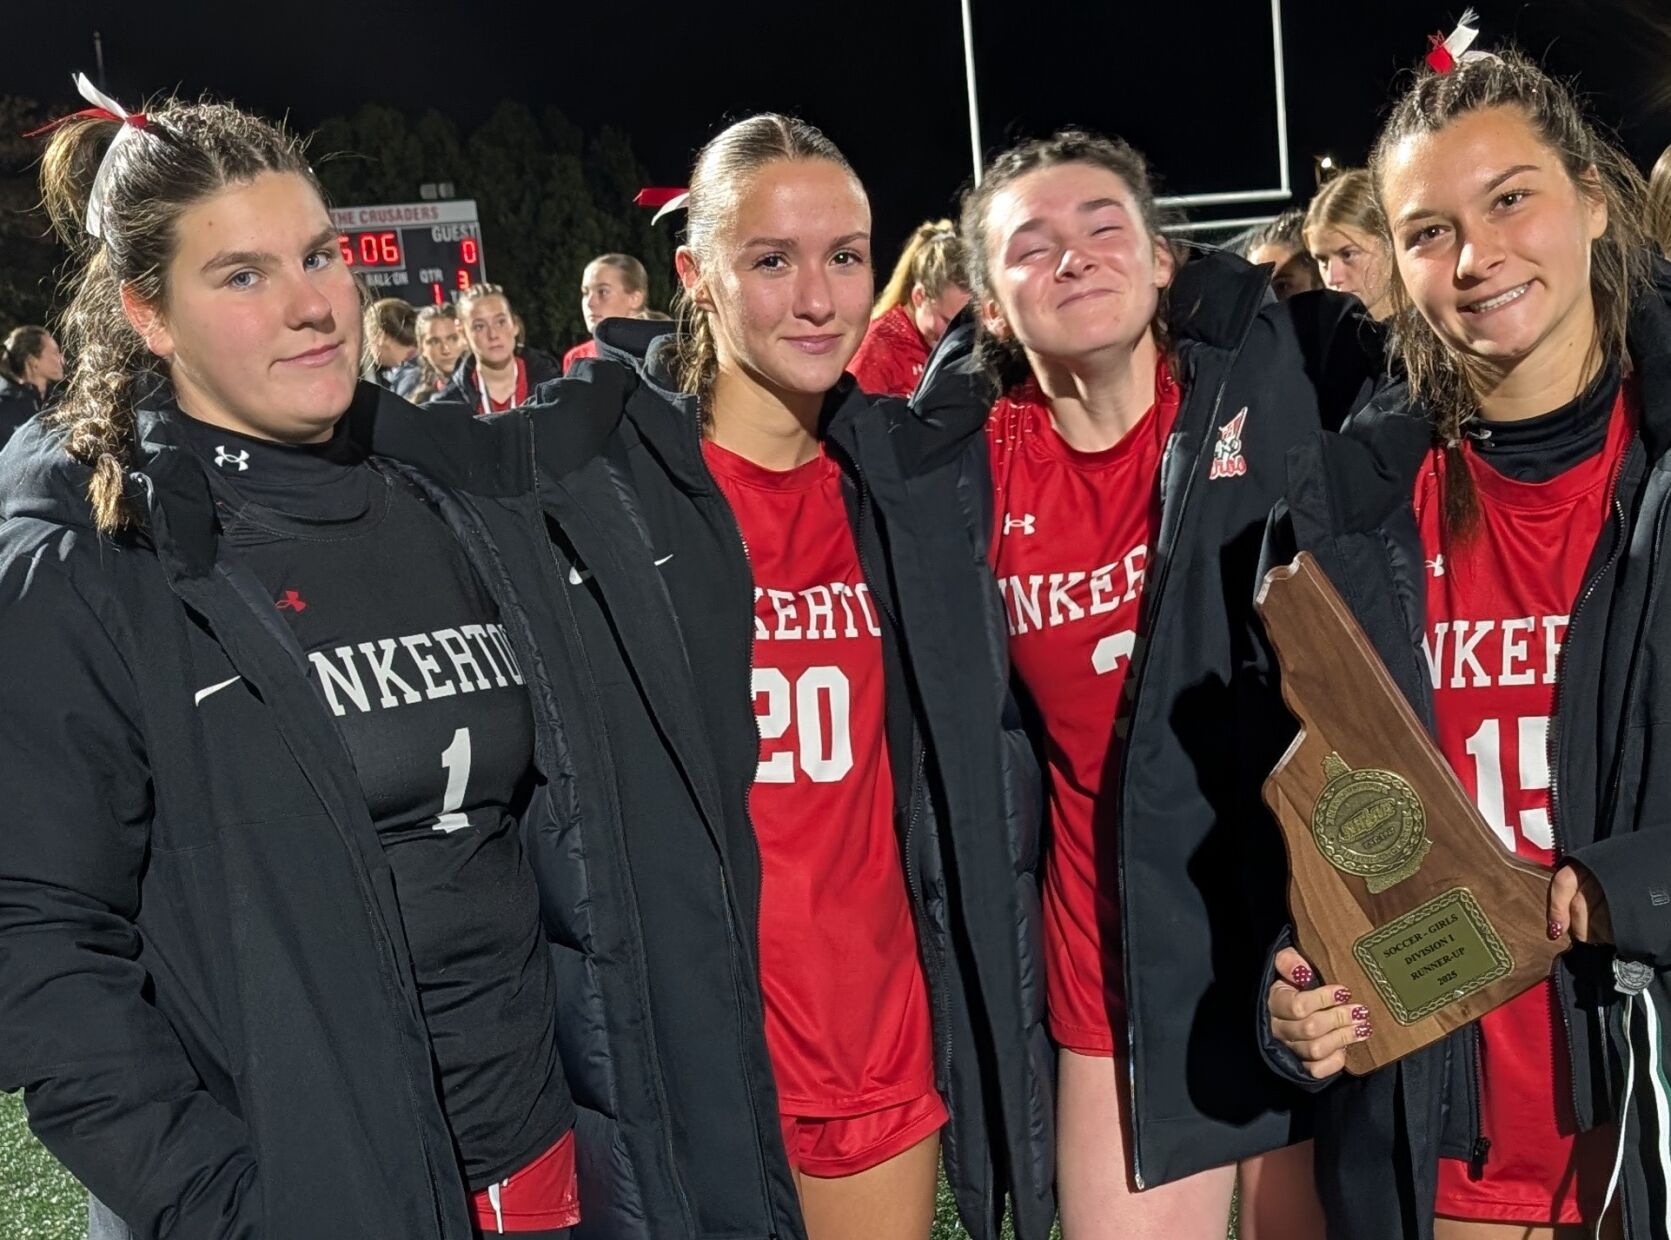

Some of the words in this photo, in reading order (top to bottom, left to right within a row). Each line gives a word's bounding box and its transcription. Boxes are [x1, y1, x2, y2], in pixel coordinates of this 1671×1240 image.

[359, 206, 439, 225] CRUSADERS
[432, 223, 476, 242] GUEST
[462, 240, 477, 264] 0
[419, 268, 444, 284] QTR
[751, 666, 854, 783] 20
[432, 727, 472, 833] 1
[1465, 716, 1554, 852] 15
[1383, 933, 1423, 958] SOCCER
[1428, 913, 1458, 934] GIRLS
[1404, 937, 1448, 965] DIVISION
[1410, 947, 1465, 980] RUNNER-UP
[1437, 970, 1457, 985] 2025
